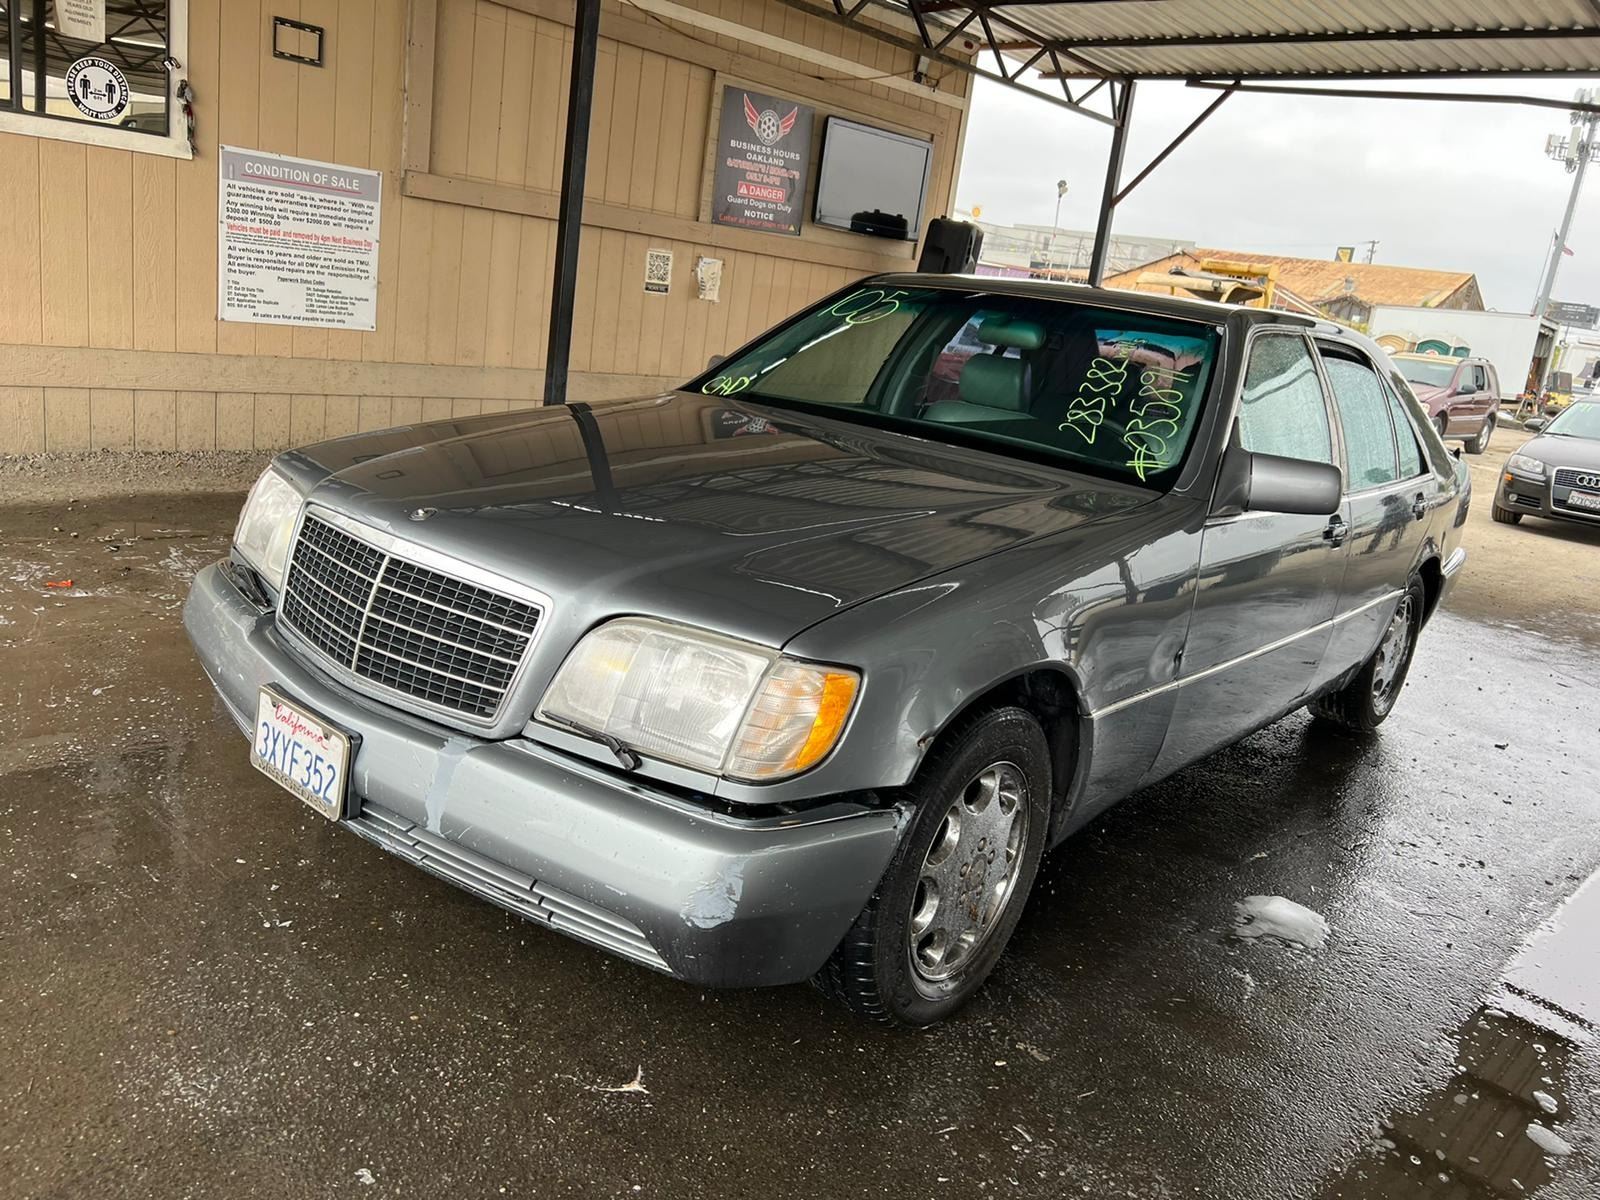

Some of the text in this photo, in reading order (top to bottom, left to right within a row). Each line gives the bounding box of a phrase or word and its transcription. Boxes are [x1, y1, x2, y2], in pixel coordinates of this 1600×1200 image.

[68, 60, 128, 105] PLEASE KEEP YOUR DISTANCE
[79, 103, 118, 119] WAIT HERE
[730, 140, 800, 160] BUSINESS HOURS
[746, 152, 784, 166] OAKLAND
[245, 162, 359, 190] CONDITION OF SALE
[238, 185, 266, 194] vehicles
[749, 186, 783, 200] DANGER
[227, 191, 264, 201] guarantees
[274, 198, 308, 207] warranties
[310, 204, 341, 212] expressed
[727, 195, 748, 205] Guard
[749, 199, 766, 209] Dogs
[777, 203, 792, 214] Duty
[226, 214, 248, 223] deposit
[240, 202, 263, 211] winning
[319, 213, 346, 221] immediate
[251, 211, 274, 219] Winning
[744, 209, 774, 220] NOTICE
[227, 223, 248, 232] Vehicles
[249, 226, 262, 234] must
[263, 227, 268, 235] be
[270, 228, 281, 237] paid
[282, 230, 292, 238] and
[293, 231, 313, 240] removed
[314, 234, 320, 242] by
[332, 236, 342, 244] Next
[343, 237, 363, 246] Business
[238, 246, 264, 254] vehicles
[254, 257, 287, 265] responsible
[328, 271, 363, 280] responsibility
[817, 288, 909, 324] 105
[701, 375, 751, 397] CAD
[274, 703, 329, 751] California
[259, 721, 336, 805] 3XYF352
